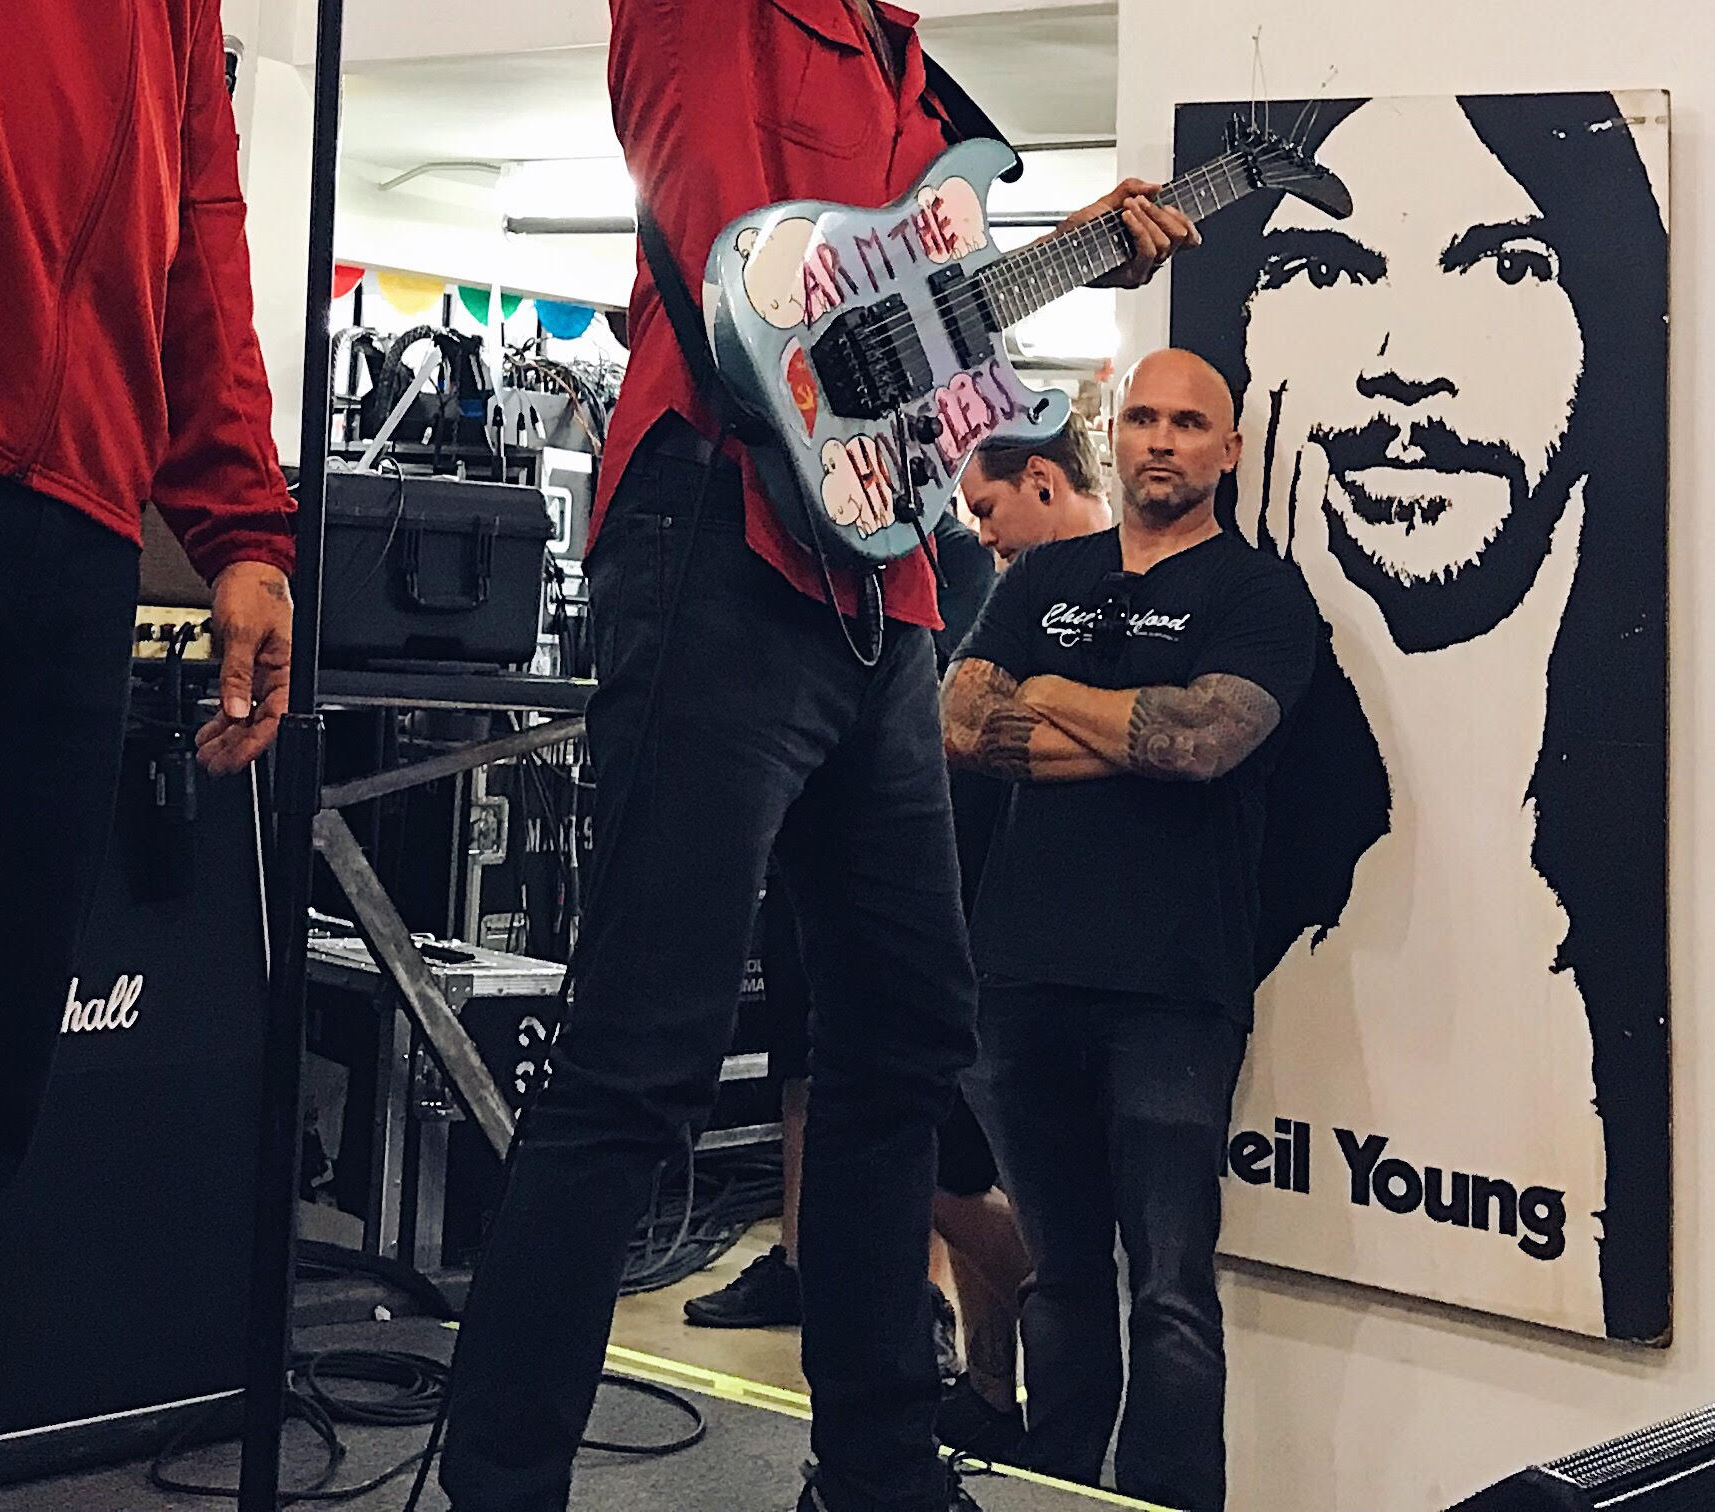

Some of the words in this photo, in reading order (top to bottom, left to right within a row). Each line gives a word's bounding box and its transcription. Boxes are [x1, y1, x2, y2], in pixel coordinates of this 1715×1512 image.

[803, 226, 896, 331] ARM
[888, 196, 958, 264] THE
[1220, 1116, 1310, 1195] eil
[1332, 1127, 1567, 1261] Young
